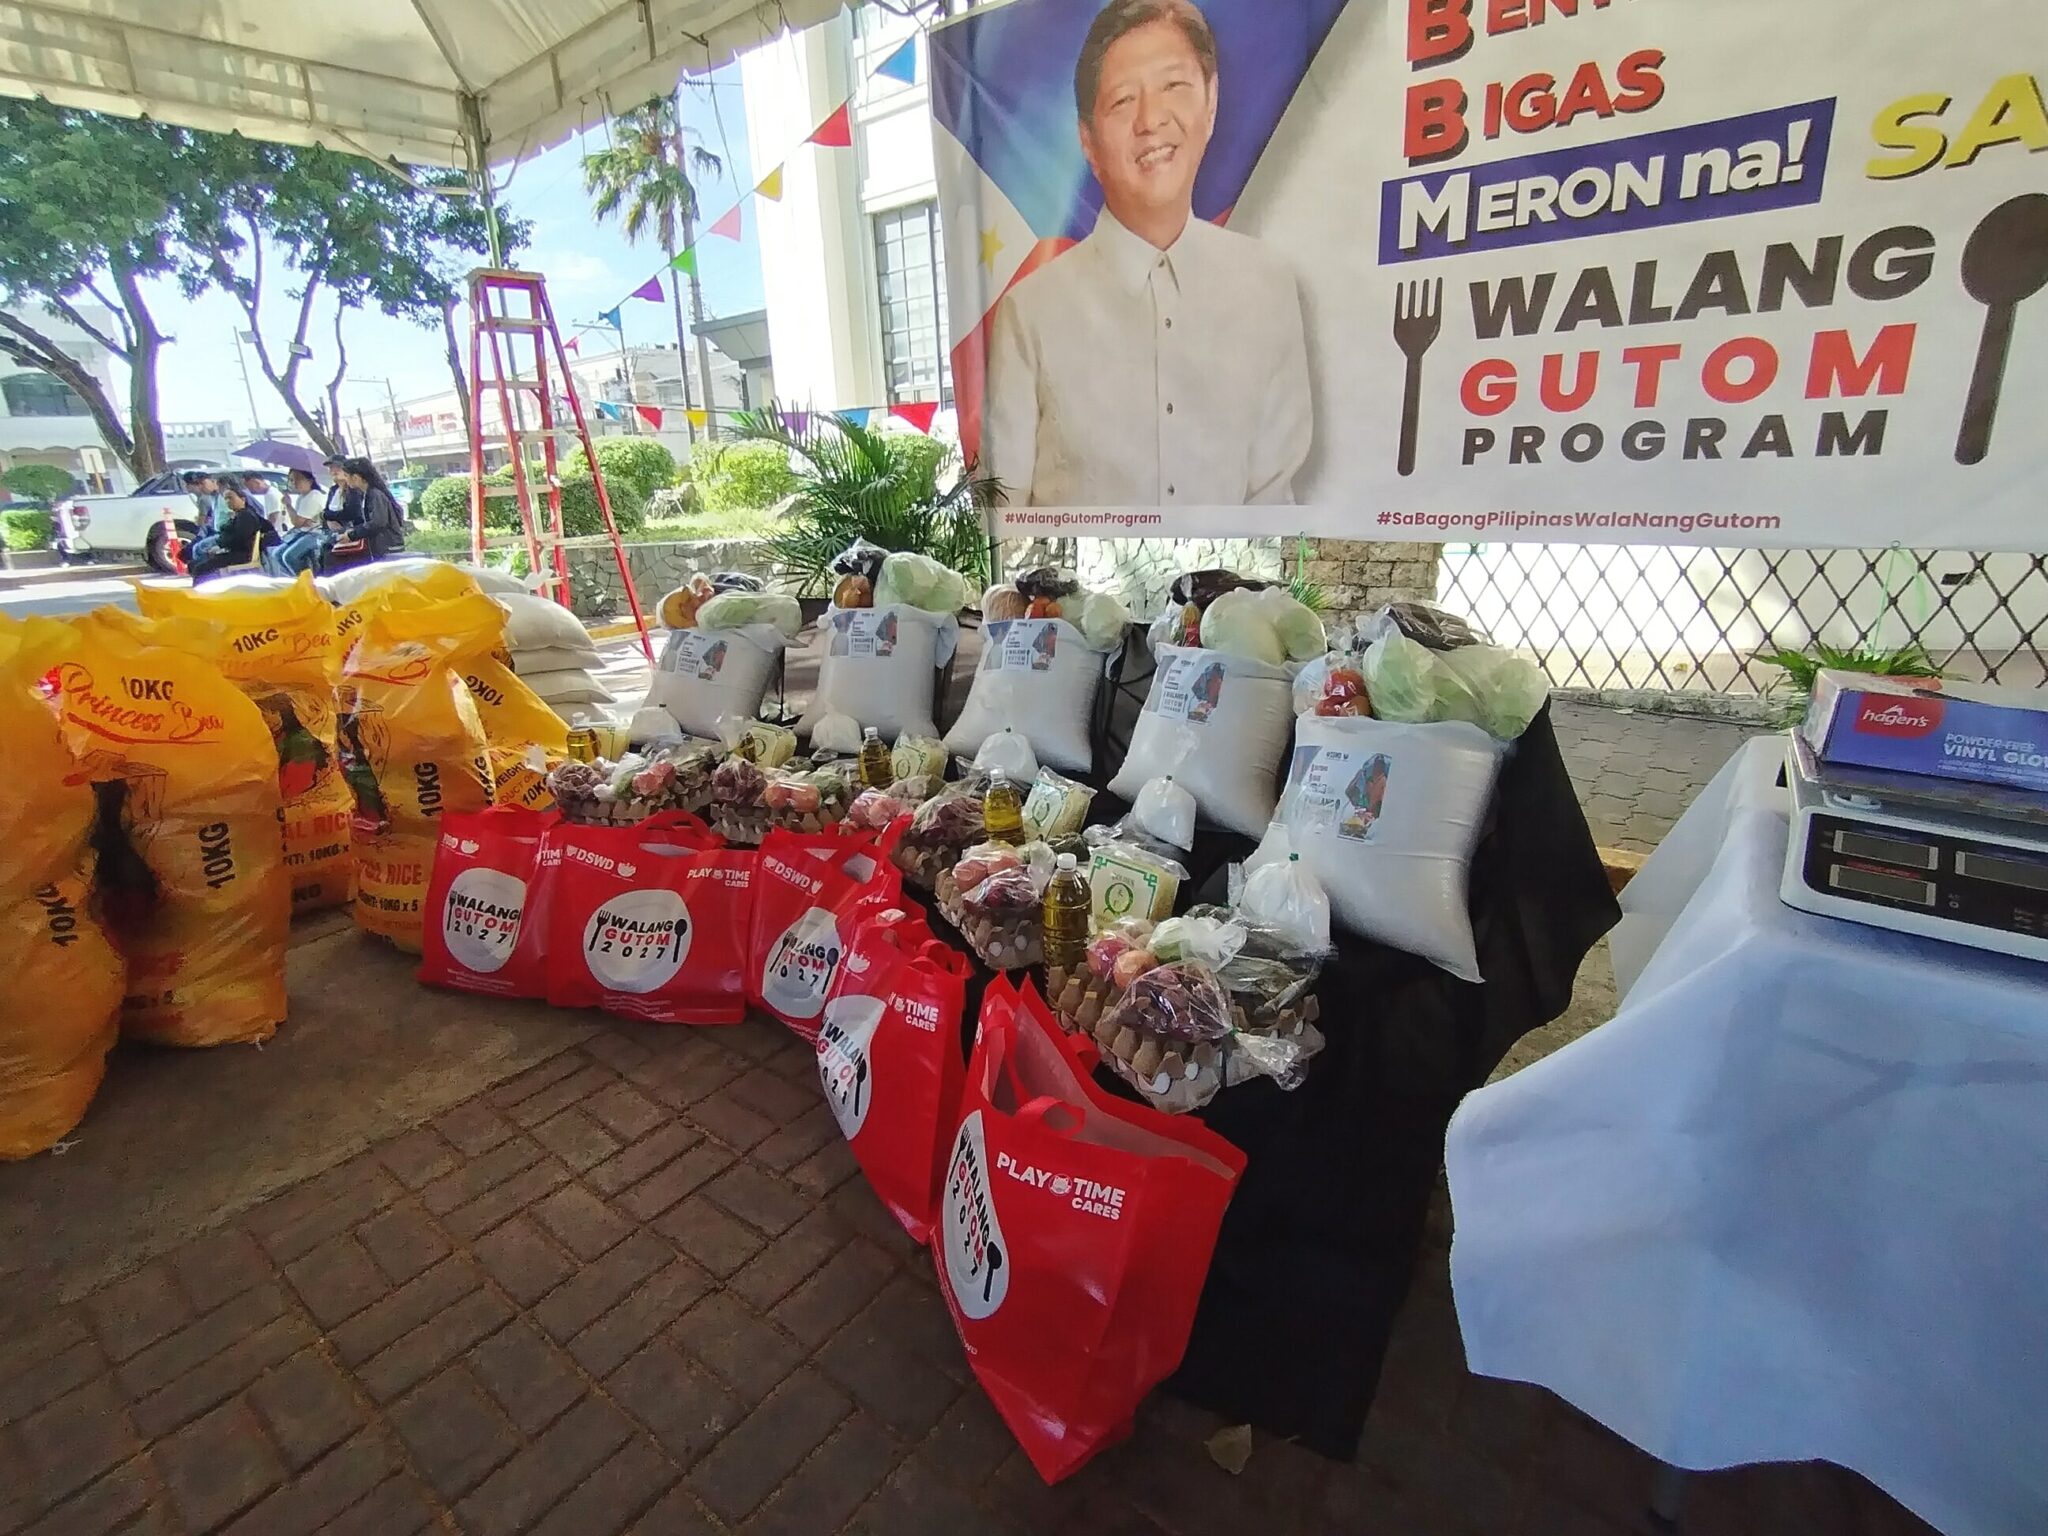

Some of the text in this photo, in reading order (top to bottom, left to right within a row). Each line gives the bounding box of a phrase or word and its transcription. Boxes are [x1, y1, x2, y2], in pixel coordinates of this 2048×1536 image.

[1403, 49, 1666, 168] BIGAS
[1399, 119, 1812, 252] MERON na!
[1468, 225, 1936, 339] WALANG
[1460, 323, 1917, 416] GUTOM
[1461, 409, 1888, 466] PROGRAM
[1004, 512, 1161, 527] #WalangGutomProgram
[1376, 511, 1781, 533] #SaBagongPilipinasWalaNangGutom
[232, 628, 280, 653] 10KG
[465, 675, 504, 706] 10KG
[1862, 709, 1930, 728] hagen's
[1944, 743, 1996, 761] VINYL
[414, 762, 443, 817] 10KG
[199, 822, 235, 889] 10KG
[576, 848, 614, 870] DSWD
[687, 868, 750, 880] PLAY TIME
[775, 863, 811, 889] DSWD
[457, 894, 519, 920] WALANG
[454, 907, 515, 933] GUTOM
[454, 921, 507, 943] 2027
[611, 915, 674, 933] WALANG
[604, 928, 670, 946] GUTOM
[601, 941, 665, 959] 2027
[906, 999, 939, 1022] TIME
[905, 1015, 936, 1032] CARES
[996, 1151, 1126, 1208] PLAY TIME
[964, 1140, 989, 1247] WALANG
[1071, 1197, 1121, 1220] CARES
